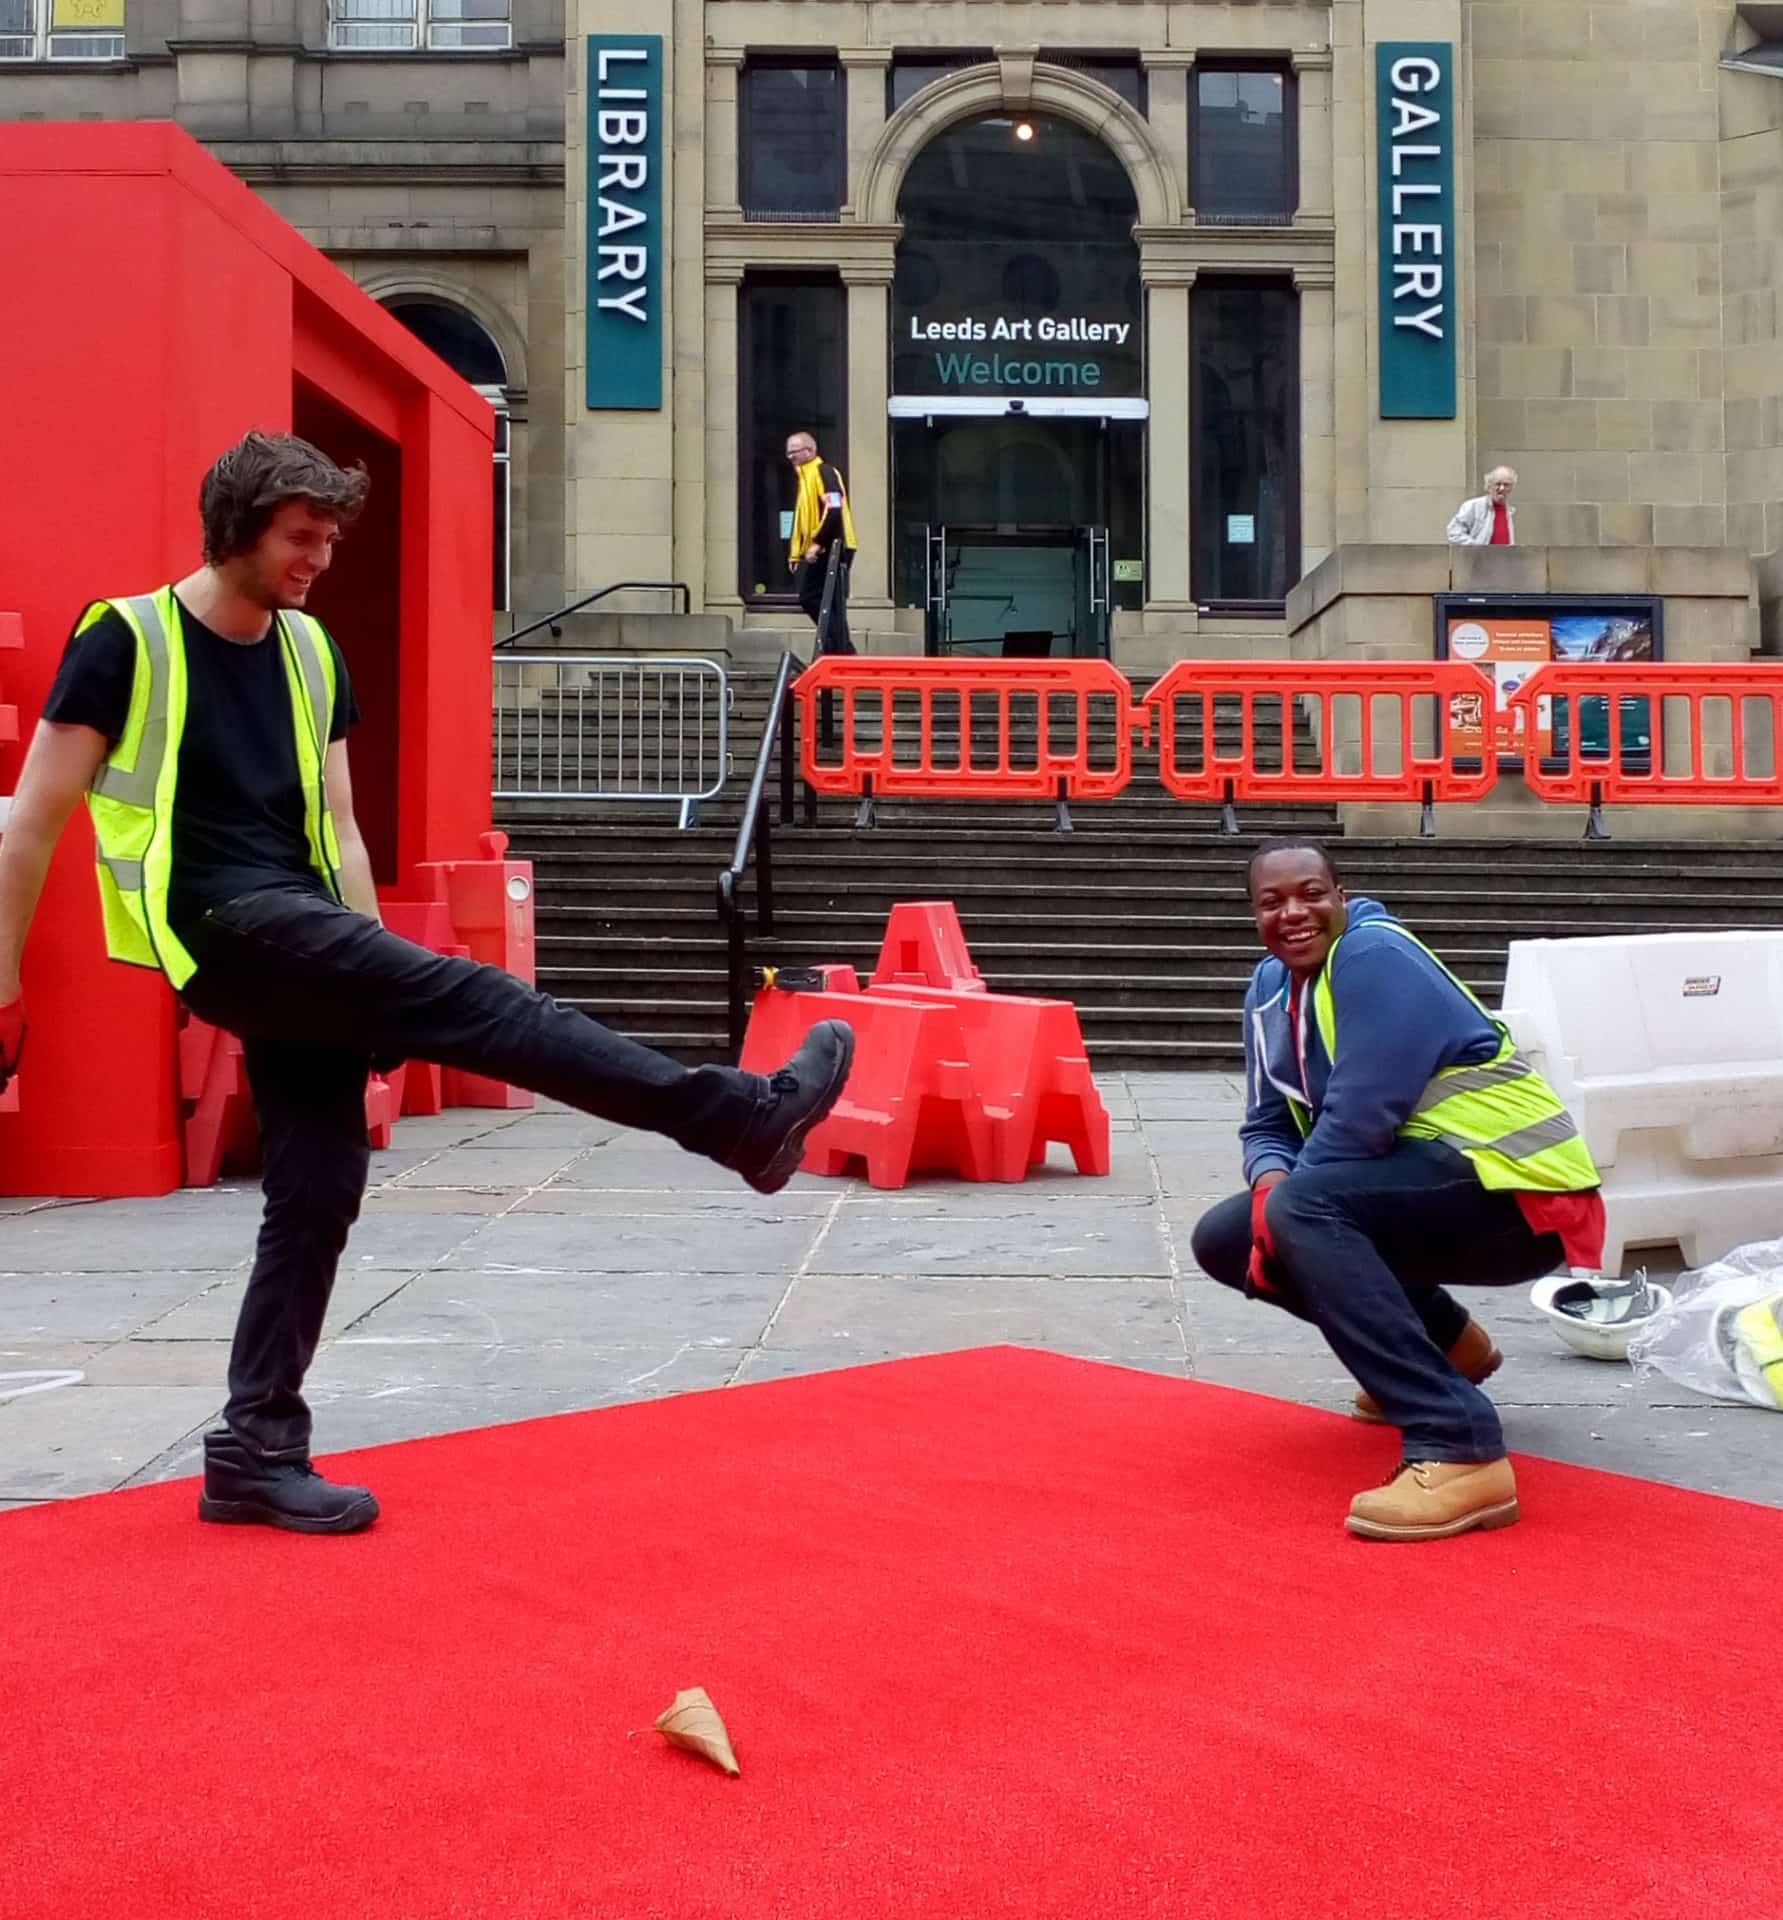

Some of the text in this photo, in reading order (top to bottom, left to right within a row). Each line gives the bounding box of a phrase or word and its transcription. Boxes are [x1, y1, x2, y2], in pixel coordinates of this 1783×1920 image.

[597, 49, 648, 322] LIBRARY
[1390, 56, 1444, 339] GALLERY
[911, 316, 1130, 345] Leeds Art Gallery
[935, 352, 1101, 385] Welcome
